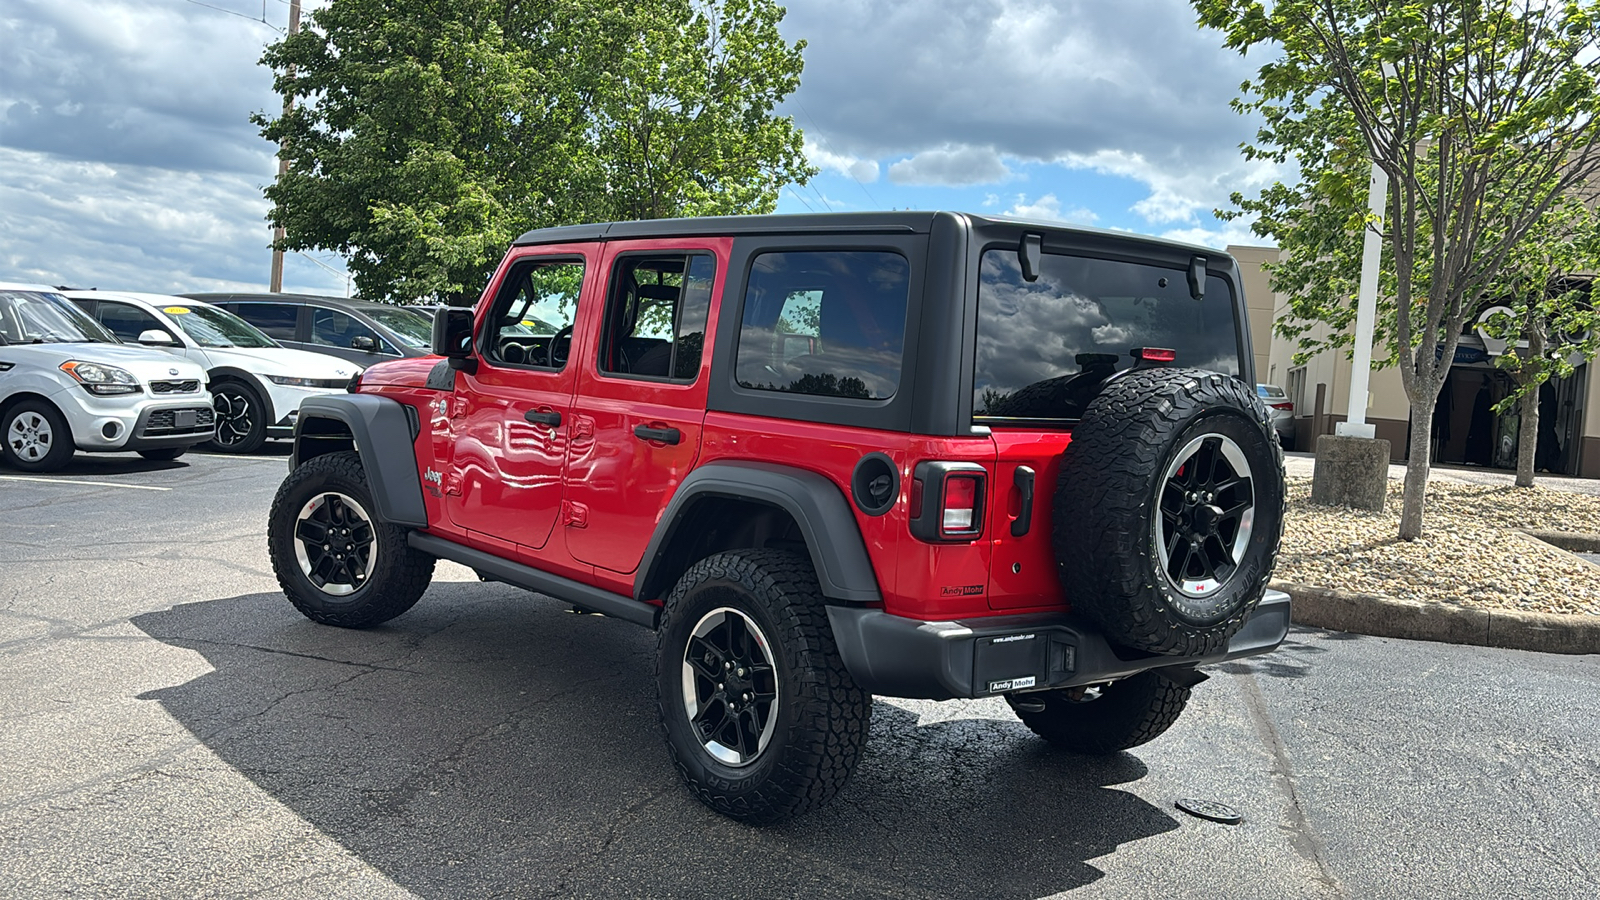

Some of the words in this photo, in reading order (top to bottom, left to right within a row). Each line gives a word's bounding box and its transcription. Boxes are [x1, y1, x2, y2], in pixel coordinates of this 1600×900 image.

[424, 466, 443, 486] Jeep
[942, 587, 962, 595] Andy
[964, 586, 983, 594] Mohr
[992, 682, 1012, 690] Andy
[1014, 679, 1034, 687] Mohr
